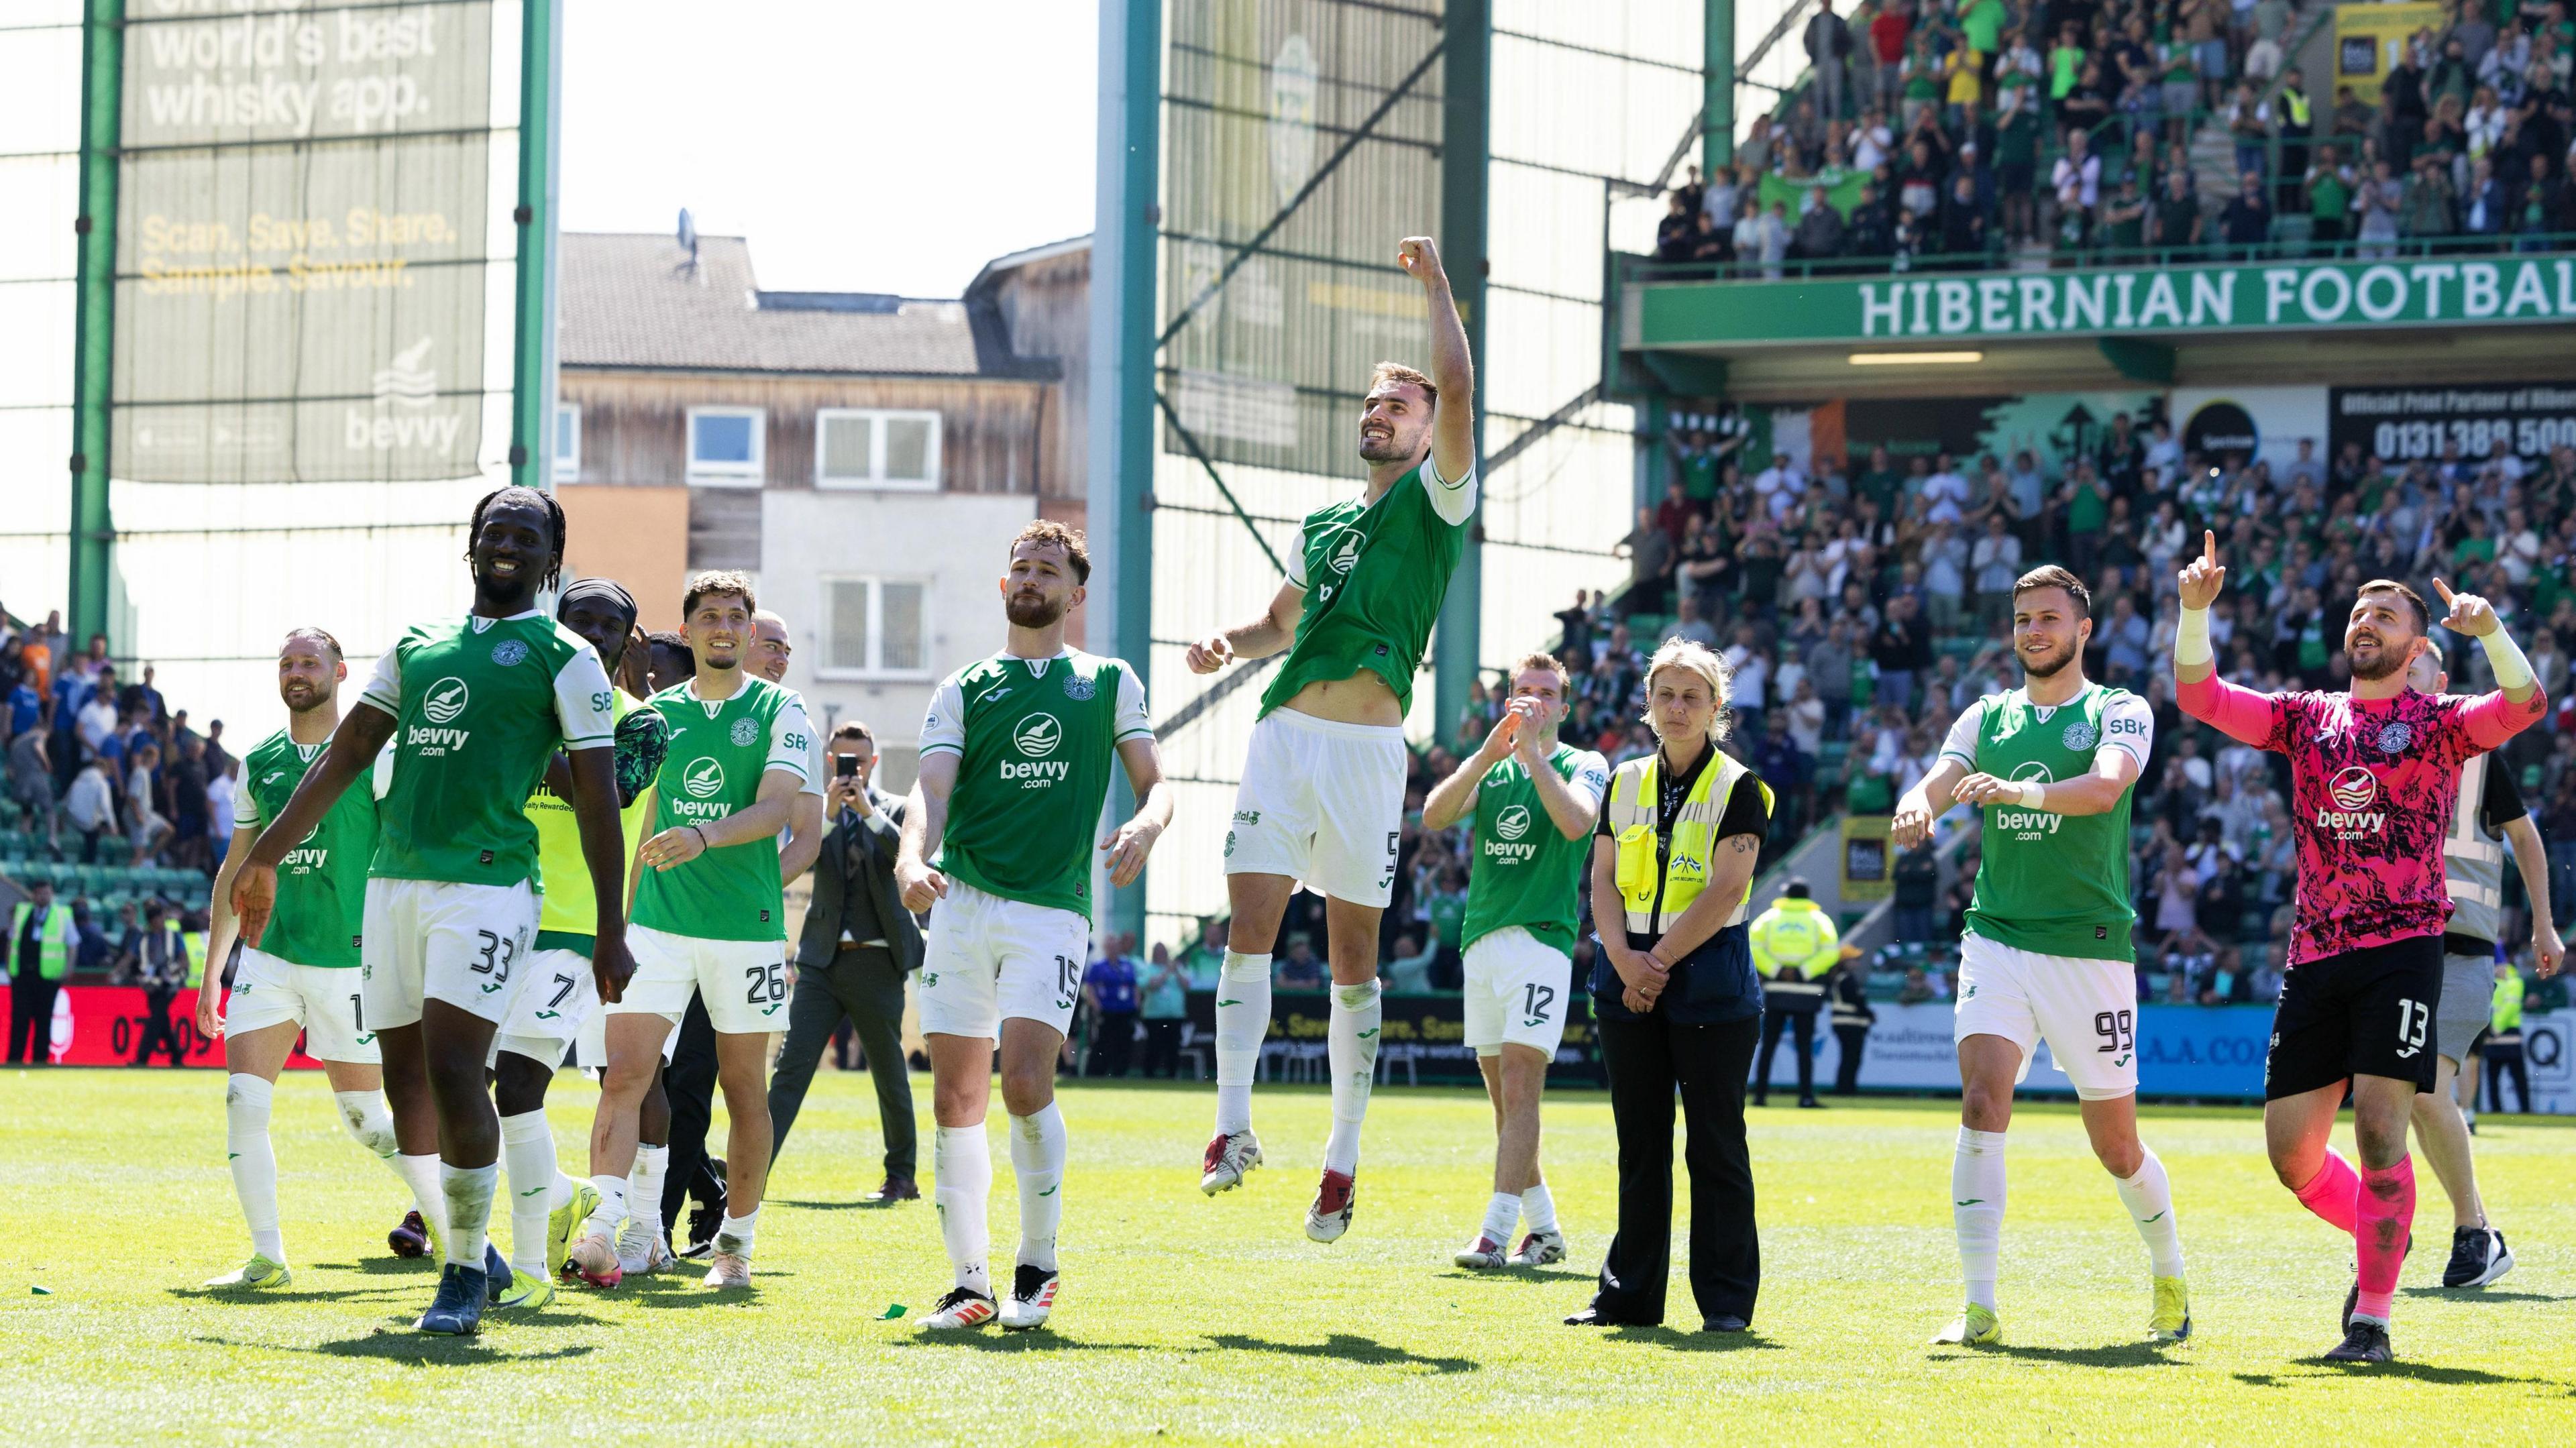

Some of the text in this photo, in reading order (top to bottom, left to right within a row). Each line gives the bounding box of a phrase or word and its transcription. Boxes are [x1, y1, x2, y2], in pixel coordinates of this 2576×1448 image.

[149, 9, 437, 68] world's best
[148, 74, 430, 135] whisky app.
[140, 207, 459, 253] Scan. Save. Share.
[140, 252, 415, 302] Sample. Savour.
[1858, 270, 2239, 337] HIBERNIAN
[344, 408, 463, 457] bevvy
[2373, 421, 2443, 461] 0131
[407, 725, 470, 751] bevvy
[2110, 719, 2147, 742] SBK
[419, 746, 445, 757] .com
[1000, 759, 1069, 781] bevvy
[1021, 779, 1051, 789] .com
[673, 797, 732, 820] bevvy
[1997, 809, 2062, 834] bevvy
[2316, 807, 2385, 833] bevvy
[1385, 832, 1399, 872] 5
[1485, 839, 1537, 860] bevvy
[2015, 831, 2042, 841] .com
[2334, 832, 2364, 841] .com
[278, 849, 327, 868] evvy
[291, 866, 309, 875] .com
[1496, 856, 1519, 865] .com
[472, 930, 514, 983] 33
[549, 973, 576, 1008] 7
[748, 964, 787, 1005] 26
[1055, 955, 1079, 1002] 15
[350, 994, 363, 1032] 1
[1525, 983, 1554, 1020] 12
[2095, 1009, 2133, 1052] 99
[2399, 998, 2429, 1048] 13
[2527, 1028, 2561, 1069] Q
